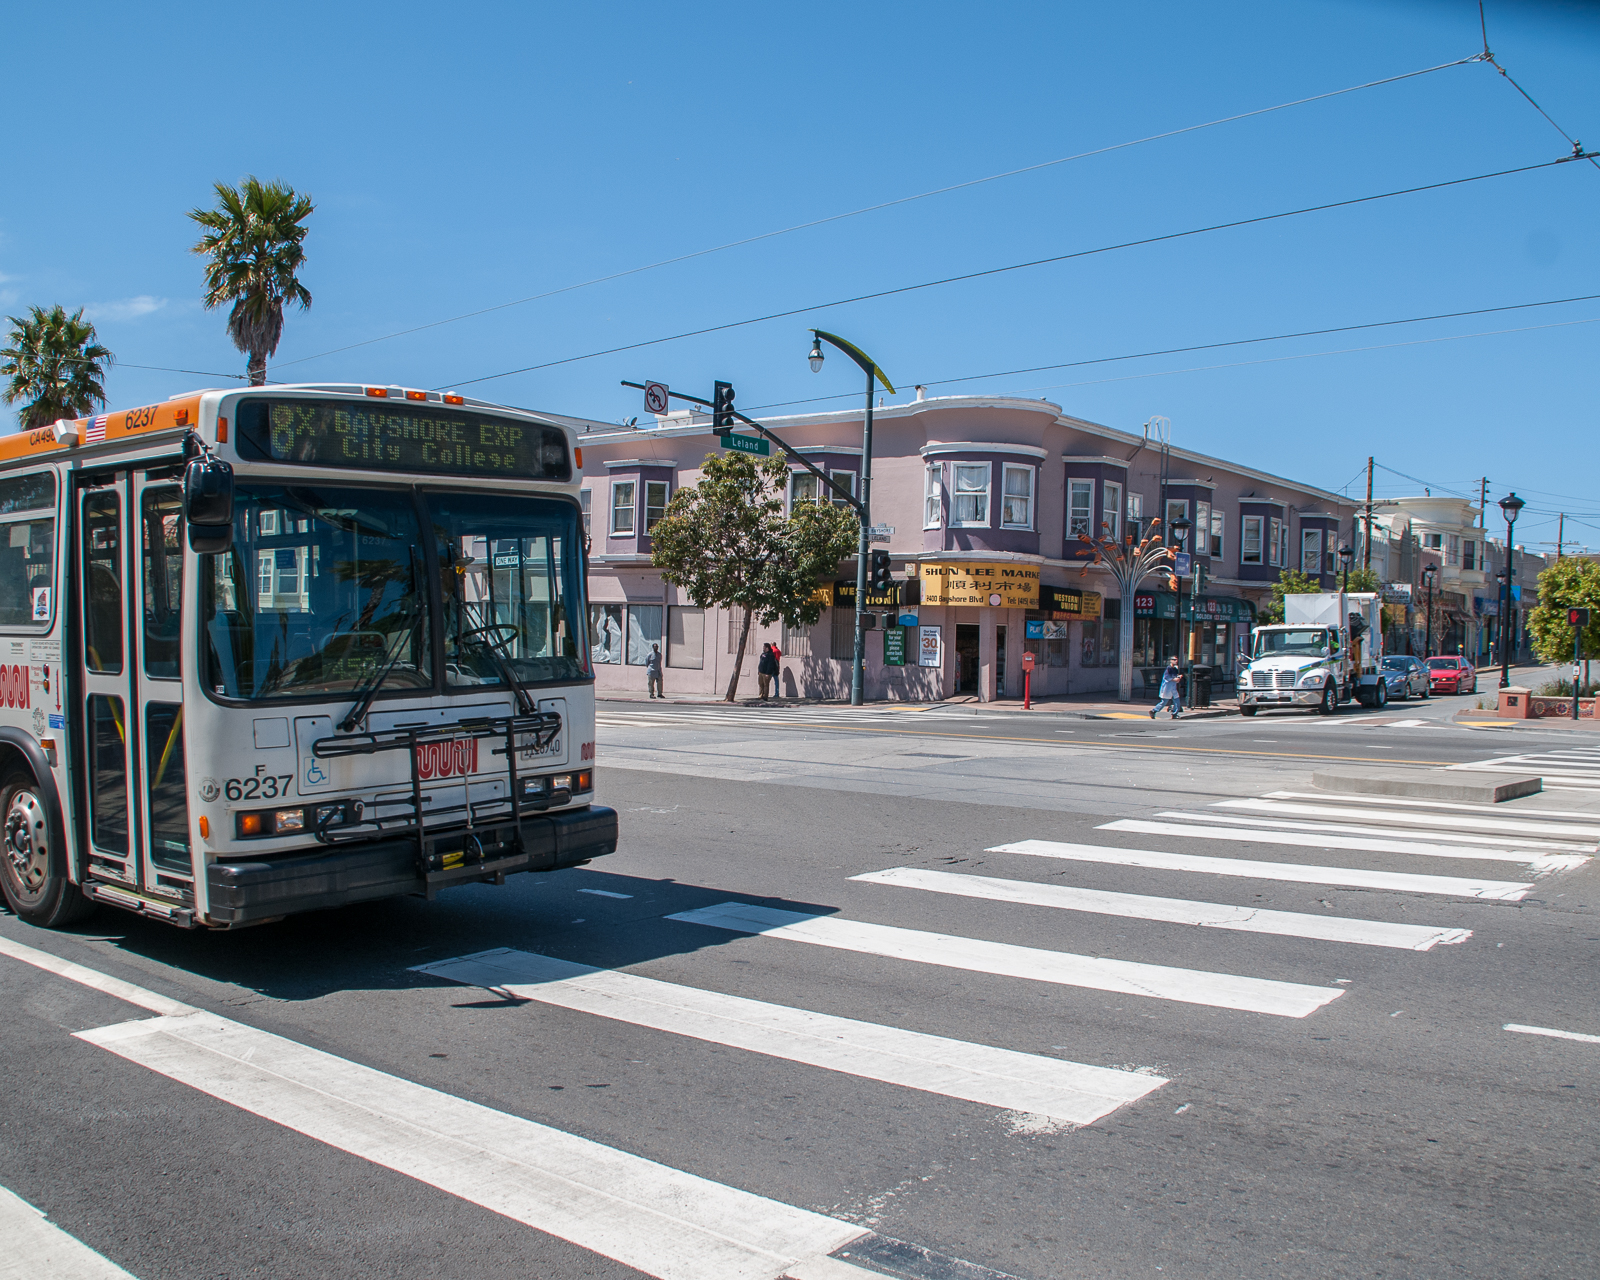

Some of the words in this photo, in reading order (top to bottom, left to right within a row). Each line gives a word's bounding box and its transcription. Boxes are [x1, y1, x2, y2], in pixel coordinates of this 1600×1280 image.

[125, 405, 159, 430] 6237
[334, 410, 466, 443] BAYSHORE
[479, 424, 523, 447] EXP
[732, 437, 759, 451] Leland
[342, 435, 400, 461] City
[422, 442, 515, 469] College
[361, 535, 386, 545] 6237
[496, 556, 507, 565] ONE
[508, 556, 519, 564] WAY
[925, 568, 959, 576] SHUN
[965, 568, 995, 577] LEE
[945, 580, 1032, 593] 順利市場
[939, 595, 967, 604] Bayshore
[968, 595, 984, 603] Blvd
[1053, 592, 1080, 603] WESTERN
[1135, 598, 1153, 607] 123
[1060, 601, 1079, 611] UNION
[1207, 601, 1216, 610] 123
[255, 764, 266, 777] F
[225, 774, 294, 801] 6237
